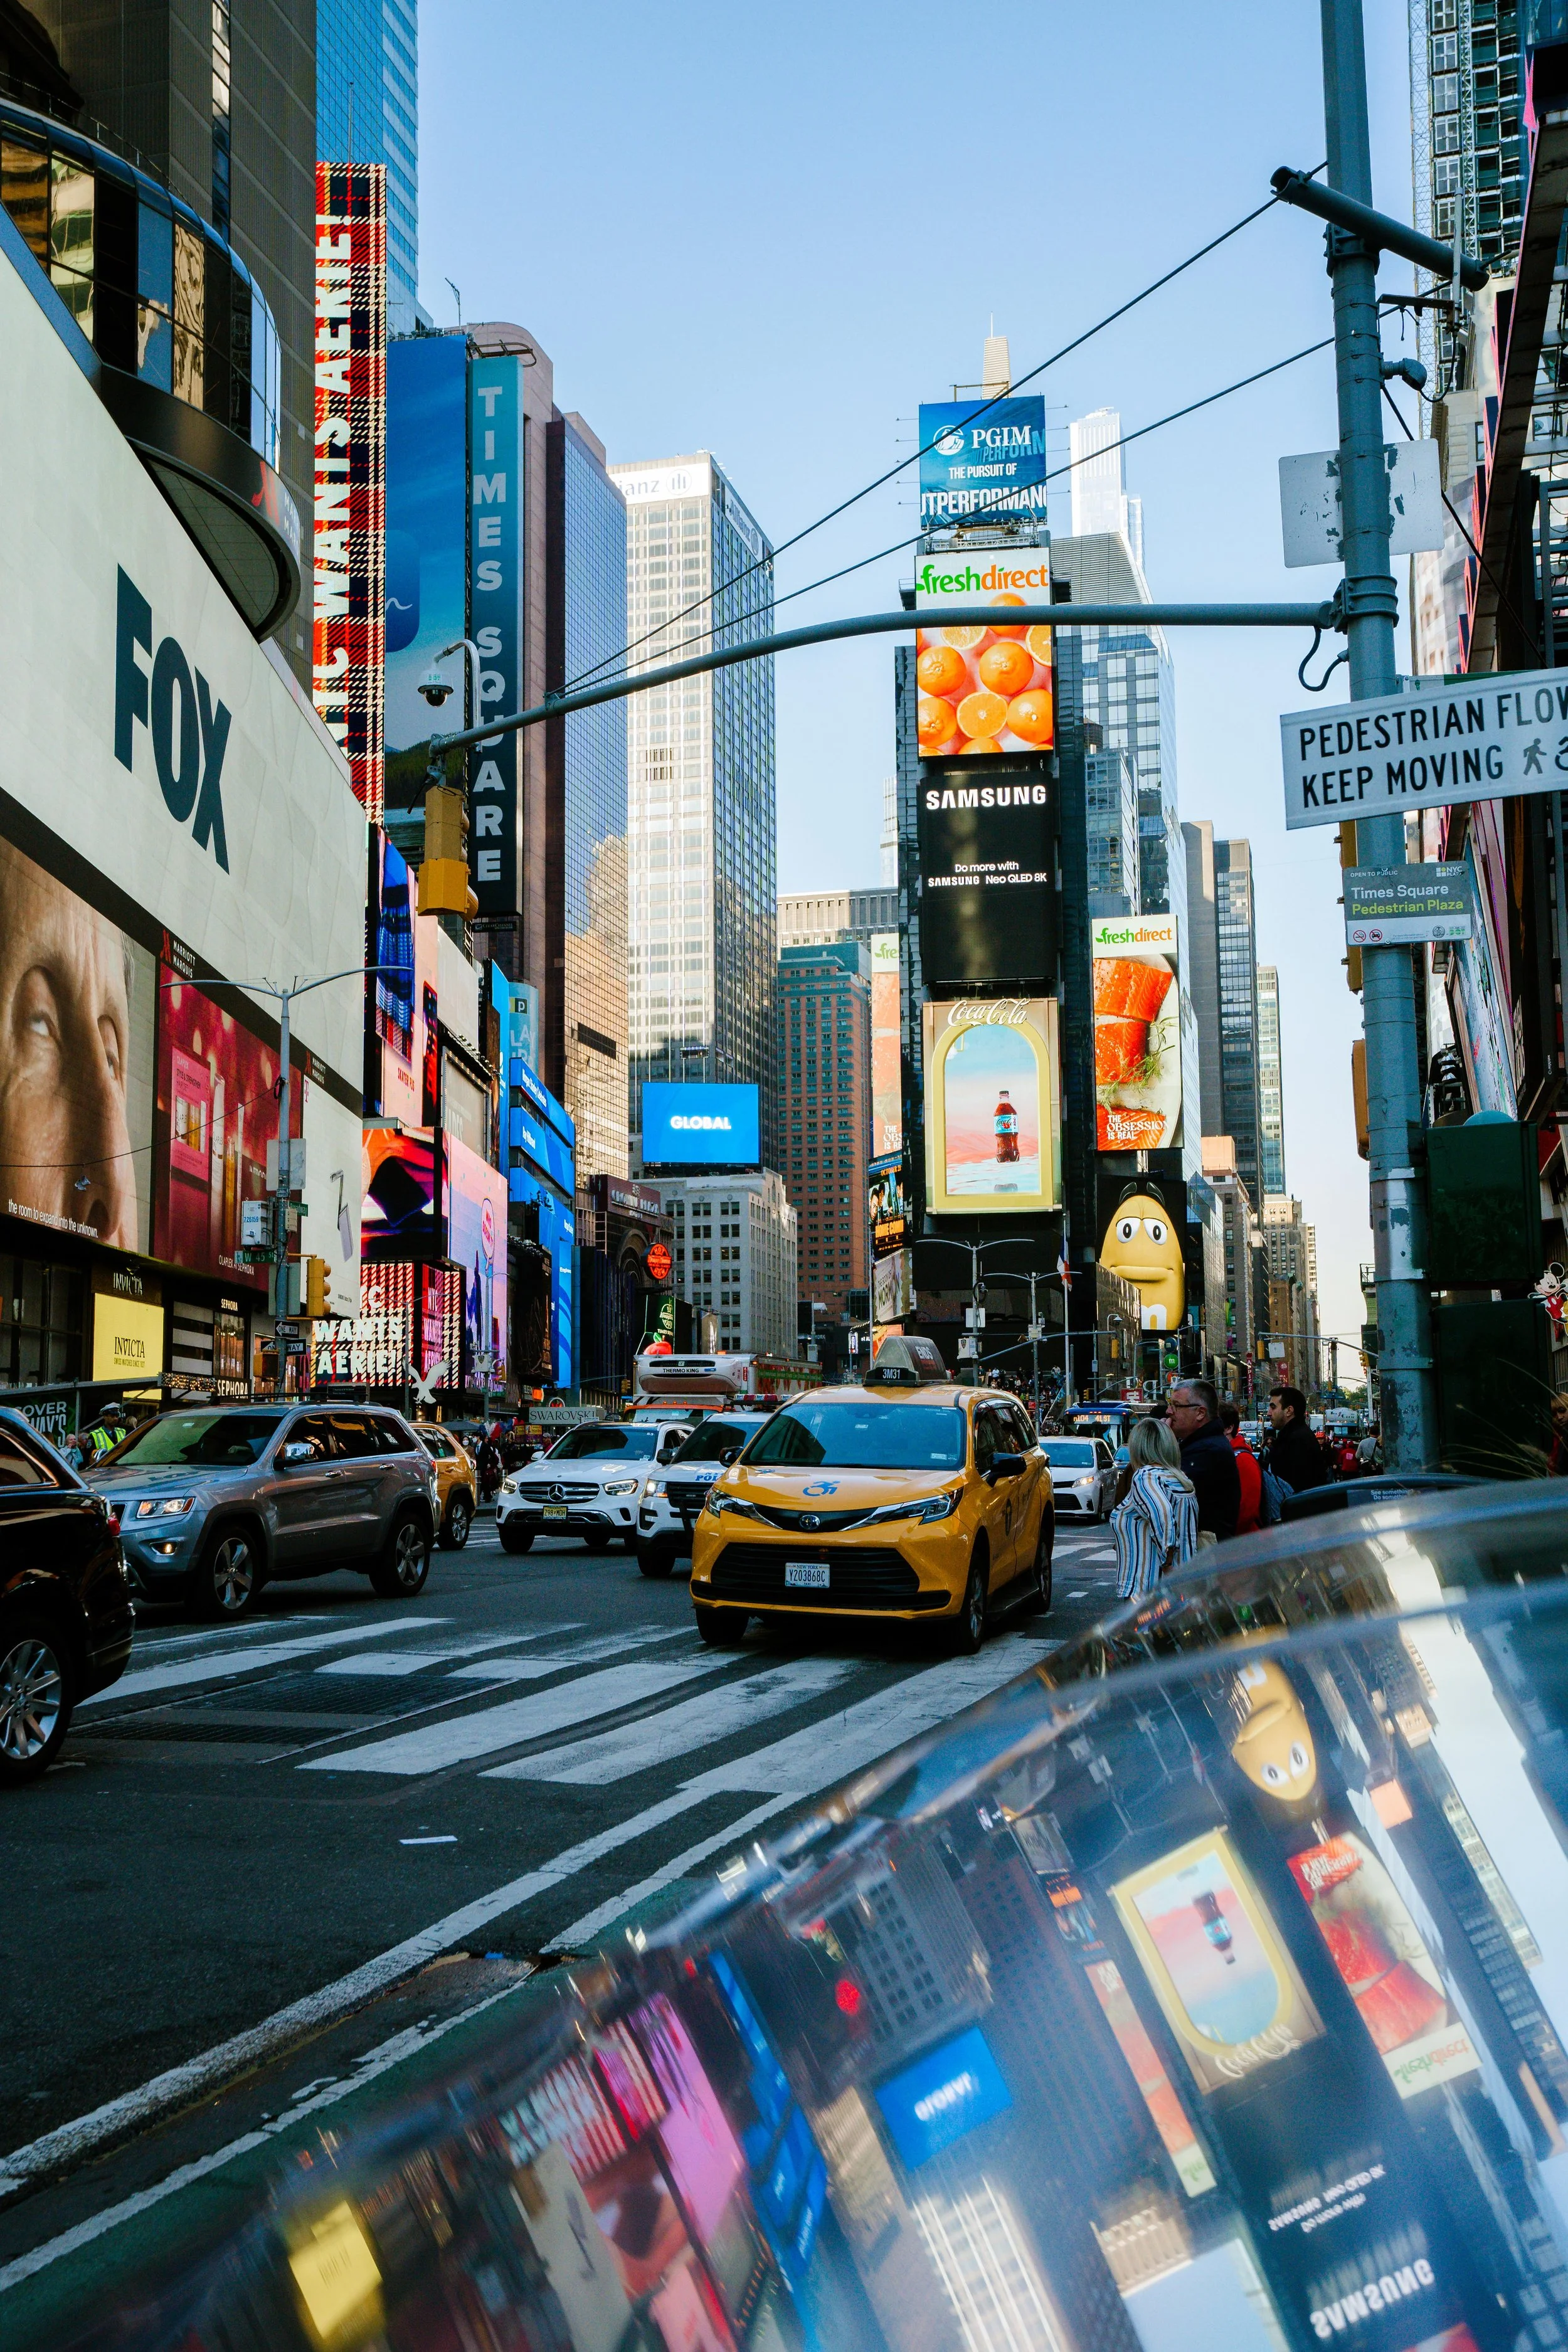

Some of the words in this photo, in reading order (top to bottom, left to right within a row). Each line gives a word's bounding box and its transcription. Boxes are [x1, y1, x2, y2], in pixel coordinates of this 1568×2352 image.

[972, 425, 1031, 449] PGIM
[948, 467, 966, 479] THE
[967, 464, 1005, 479] PURSUIT
[1005, 463, 1017, 475] OF
[619, 480, 659, 497] ianz
[314, 417, 350, 620] WANTS
[918, 564, 1048, 595] freshdirect
[114, 563, 232, 876] FOX
[1300, 697, 1485, 761] PEDESTRIAN
[1303, 766, 1374, 808] KEEP
[1386, 744, 1504, 795] MOVING
[926, 785, 1047, 810] SAMSUNG
[955, 864, 968, 872] Do
[969, 864, 996, 872] more
[997, 861, 1019, 871] with
[928, 875, 980, 887] SAMSUNG
[985, 875, 1007, 884] Neo
[1007, 874, 1032, 884] QLED
[1034, 872, 1047, 882] 8K
[1351, 886, 1394, 899] Times
[1397, 884, 1449, 899] Square
[1352, 901, 1424, 915] Pedestrian
[1427, 899, 1464, 911] Plaza
[1096, 926, 1172, 945] freshdirect
[173, 940, 196, 967] MARRIOTT
[173, 954, 193, 978] MARQUIS
[312, 1057, 326, 1074] MARRIOTT
[312, 1068, 324, 1084] MARQUIS
[670, 1116, 732, 1130] GLOBAL
[1106, 1120, 1169, 1131] OBSESSION
[1108, 1115, 1121, 1123] THE
[884, 1125, 898, 1133] THE
[1108, 1131, 1115, 1140] IS
[1117, 1131, 1136, 1140] REAL
[884, 1142, 891, 1150] IS
[881, 1167, 897, 1177] OCTOBER
[9, 1199, 18, 1213] the
[18, 1205, 33, 1218] room
[33, 1207, 39, 1221] to
[40, 1211, 58, 1226] expand
[59, 1214, 68, 1229] into
[68, 1217, 77, 1232] the
[77, 1222, 98, 1239] unknown.
[218, 1254, 233, 1268] OLAPLEX
[238, 1263, 255, 1276] SEPHORA
[245, 1253, 252, 1262] W
[255, 1253, 265, 1261] 45
[114, 1272, 143, 1296] INVICTA
[221, 1298, 238, 1311] SEPHORA
[314, 1318, 403, 1342] WANTS
[114, 1336, 146, 1359] INVICTA
[915, 1346, 934, 1360] ENDS
[317, 1350, 398, 1374] AERIE!
[882, 1369, 901, 1379] 3M31
[217, 1379, 248, 1399] SEPHORA
[530, 1411, 595, 1421] SWAROVSKI
[789, 1569, 825, 1582] Y203868C
